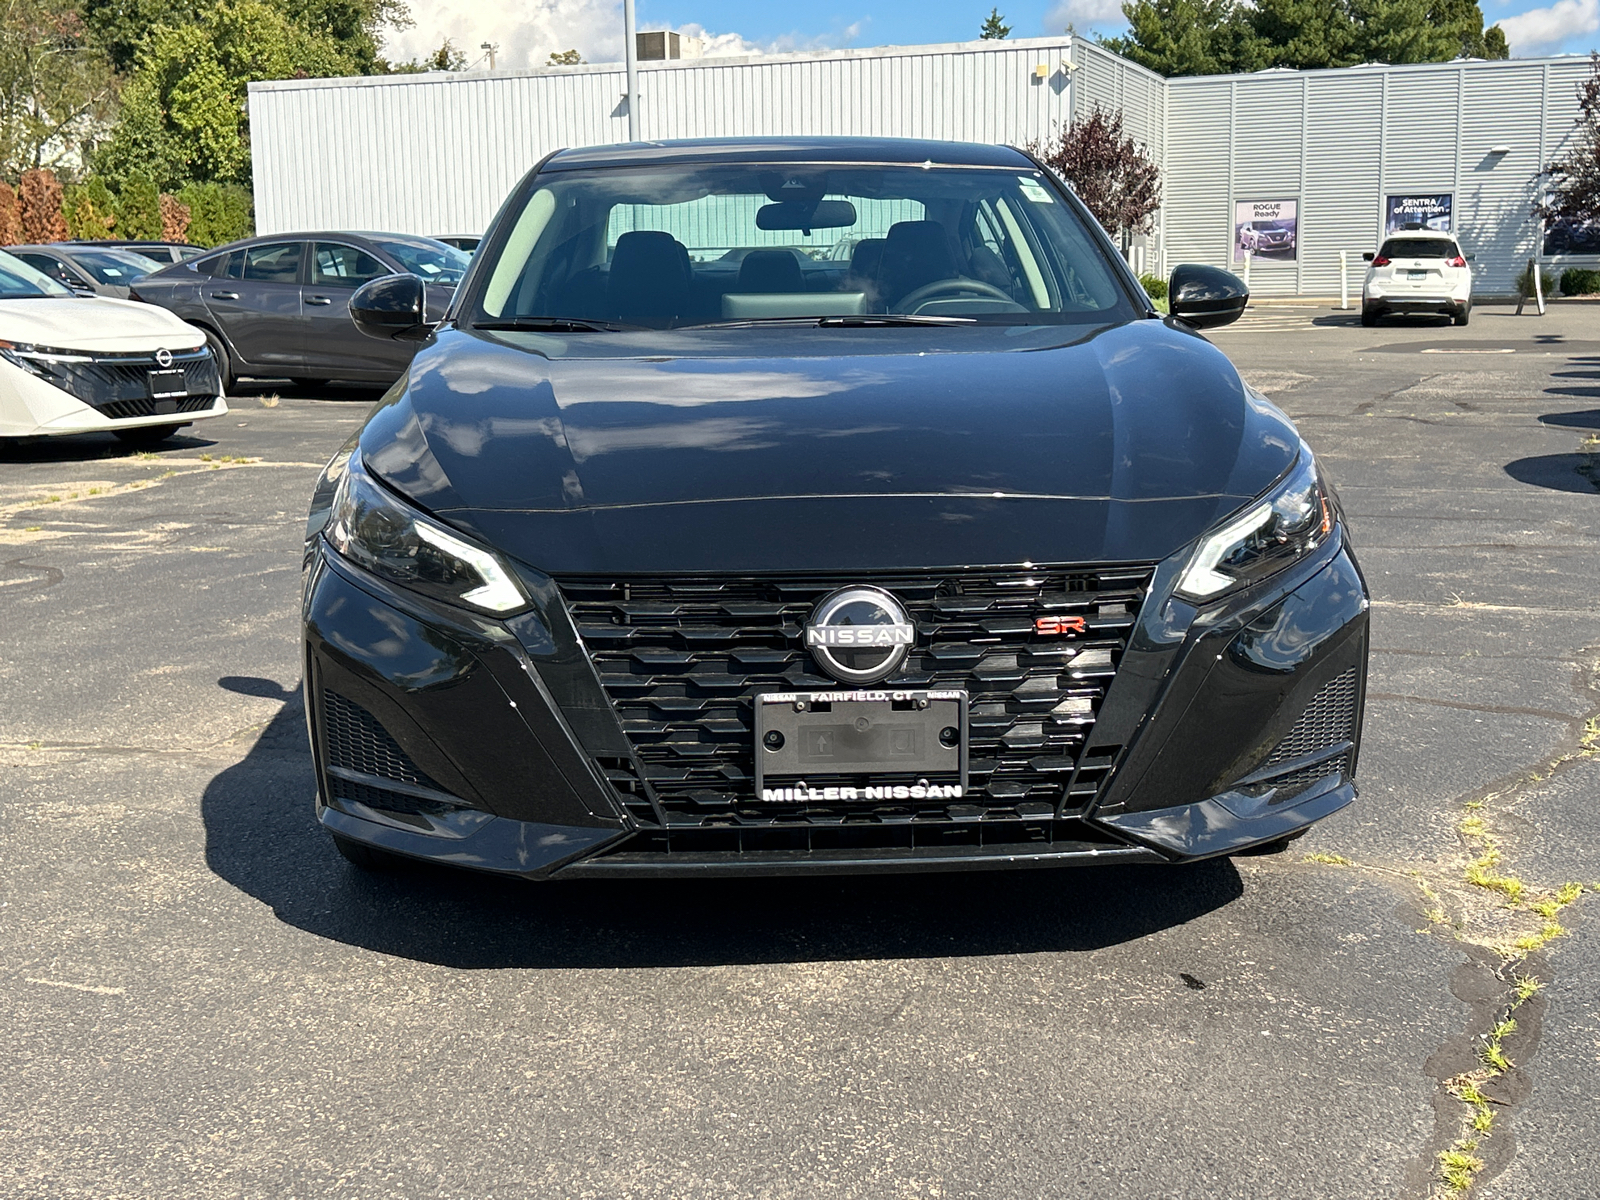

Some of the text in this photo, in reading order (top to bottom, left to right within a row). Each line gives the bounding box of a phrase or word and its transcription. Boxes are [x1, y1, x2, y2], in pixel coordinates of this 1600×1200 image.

[1402, 198, 1437, 207] SENTRA
[1393, 204, 1445, 214] of Attention
[1036, 616, 1086, 635] SR
[809, 627, 911, 644] NISSAN
[763, 693, 797, 701] NISSAN
[810, 691, 914, 702] FAIRFIELD, CT
[927, 691, 961, 699] NISSAN
[762, 785, 963, 801] MILLER NISSAN
